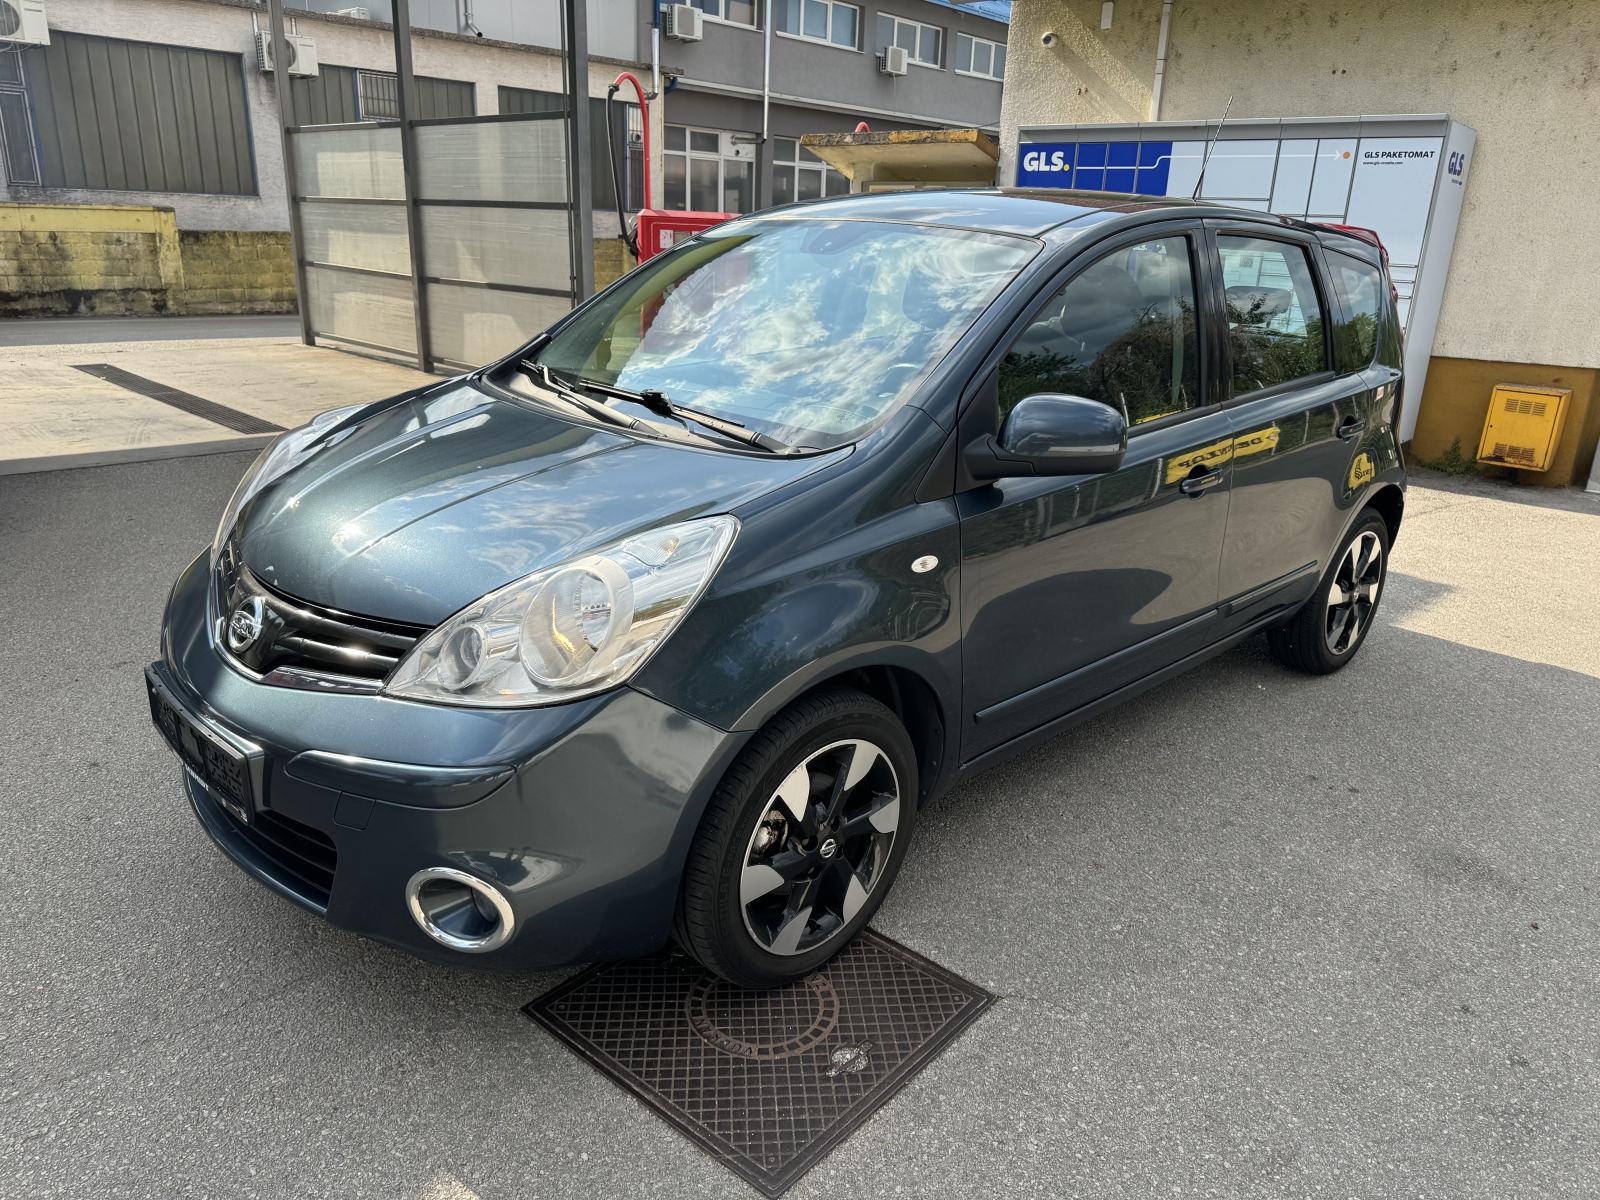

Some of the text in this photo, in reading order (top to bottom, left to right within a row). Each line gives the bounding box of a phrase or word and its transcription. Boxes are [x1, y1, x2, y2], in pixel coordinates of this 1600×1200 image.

[1364, 151, 1435, 159] GLS PAKETOMAT
[1447, 151, 1465, 176] GLS
